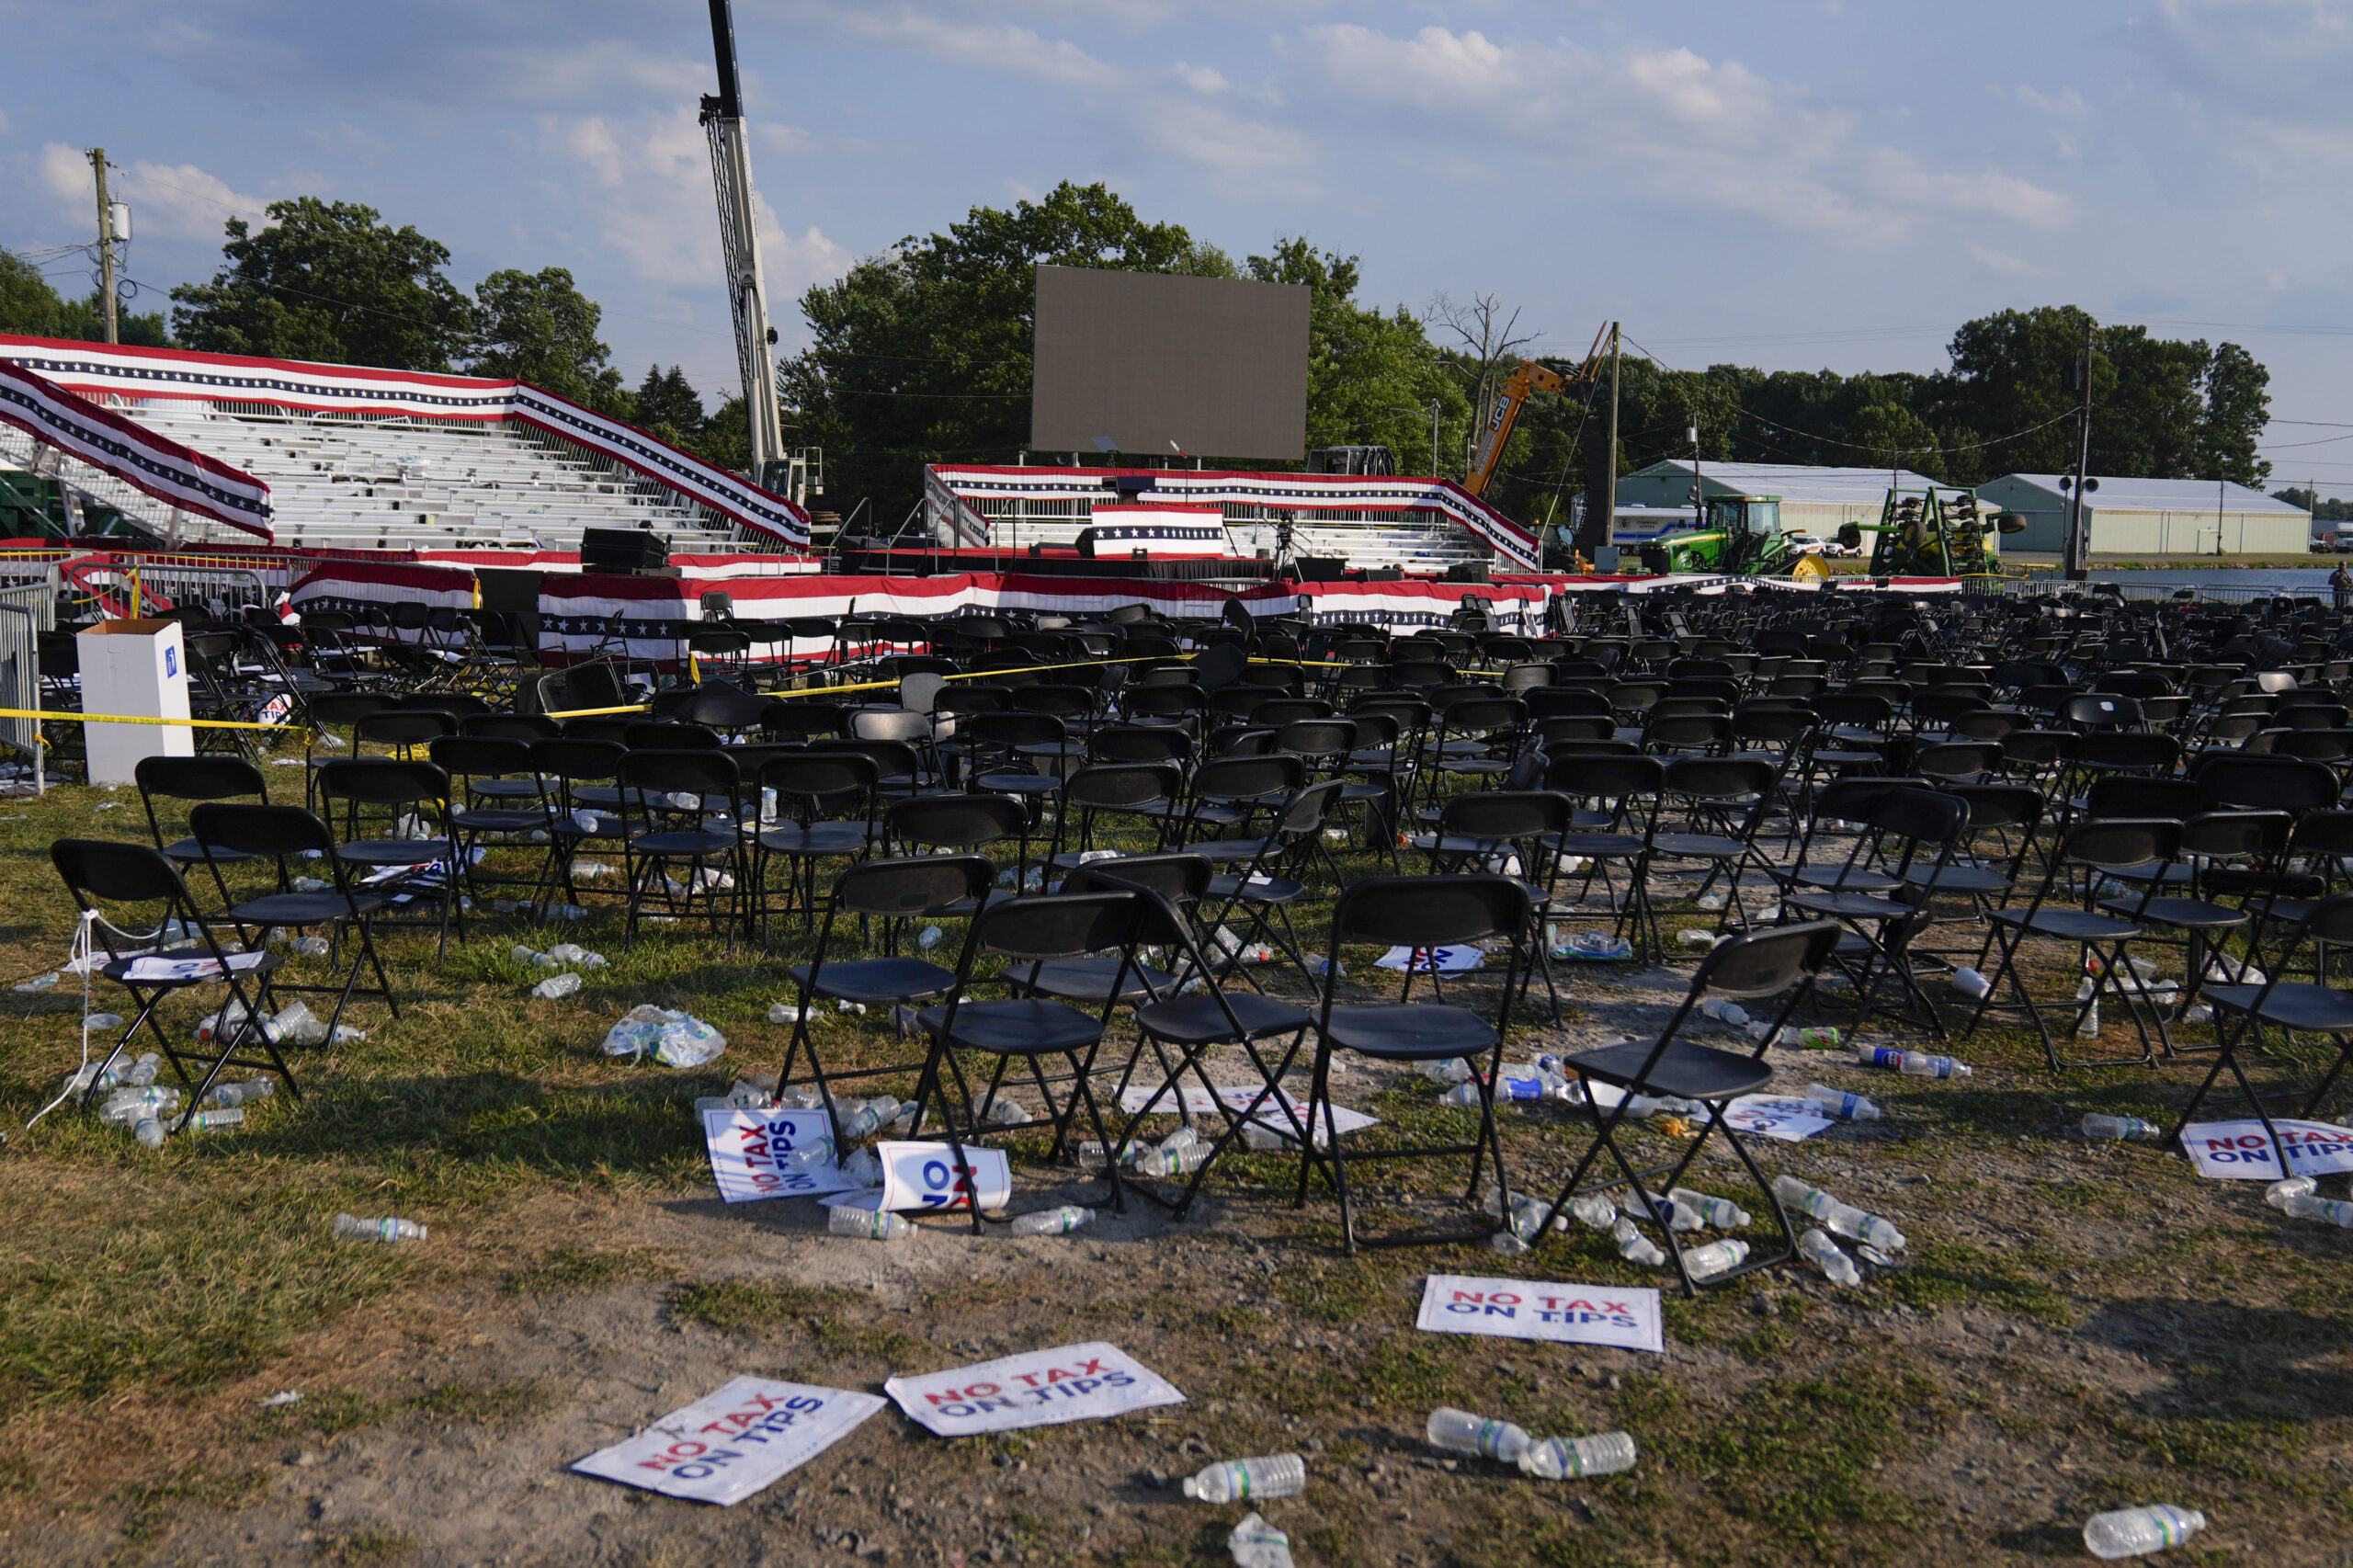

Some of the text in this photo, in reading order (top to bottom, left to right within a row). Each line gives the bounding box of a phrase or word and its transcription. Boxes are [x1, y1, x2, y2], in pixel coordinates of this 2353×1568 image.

[1492, 395, 1510, 431] JCB
[265, 701, 287, 713] AX
[739, 1124, 786, 1193] NO TAX
[768, 1120, 816, 1189] ON TIPS
[2206, 1135, 2267, 1152] NO
[2210, 1149, 2271, 1163] ON
[1446, 1302, 1638, 1327] ON TIPS
[1452, 1290, 1630, 1314] NO TAX
[925, 1358, 1114, 1405] NO TAX
[938, 1371, 1136, 1416] ON TIPS
[636, 1392, 789, 1471] NO TAX
[672, 1396, 824, 1479] ON TIPS
